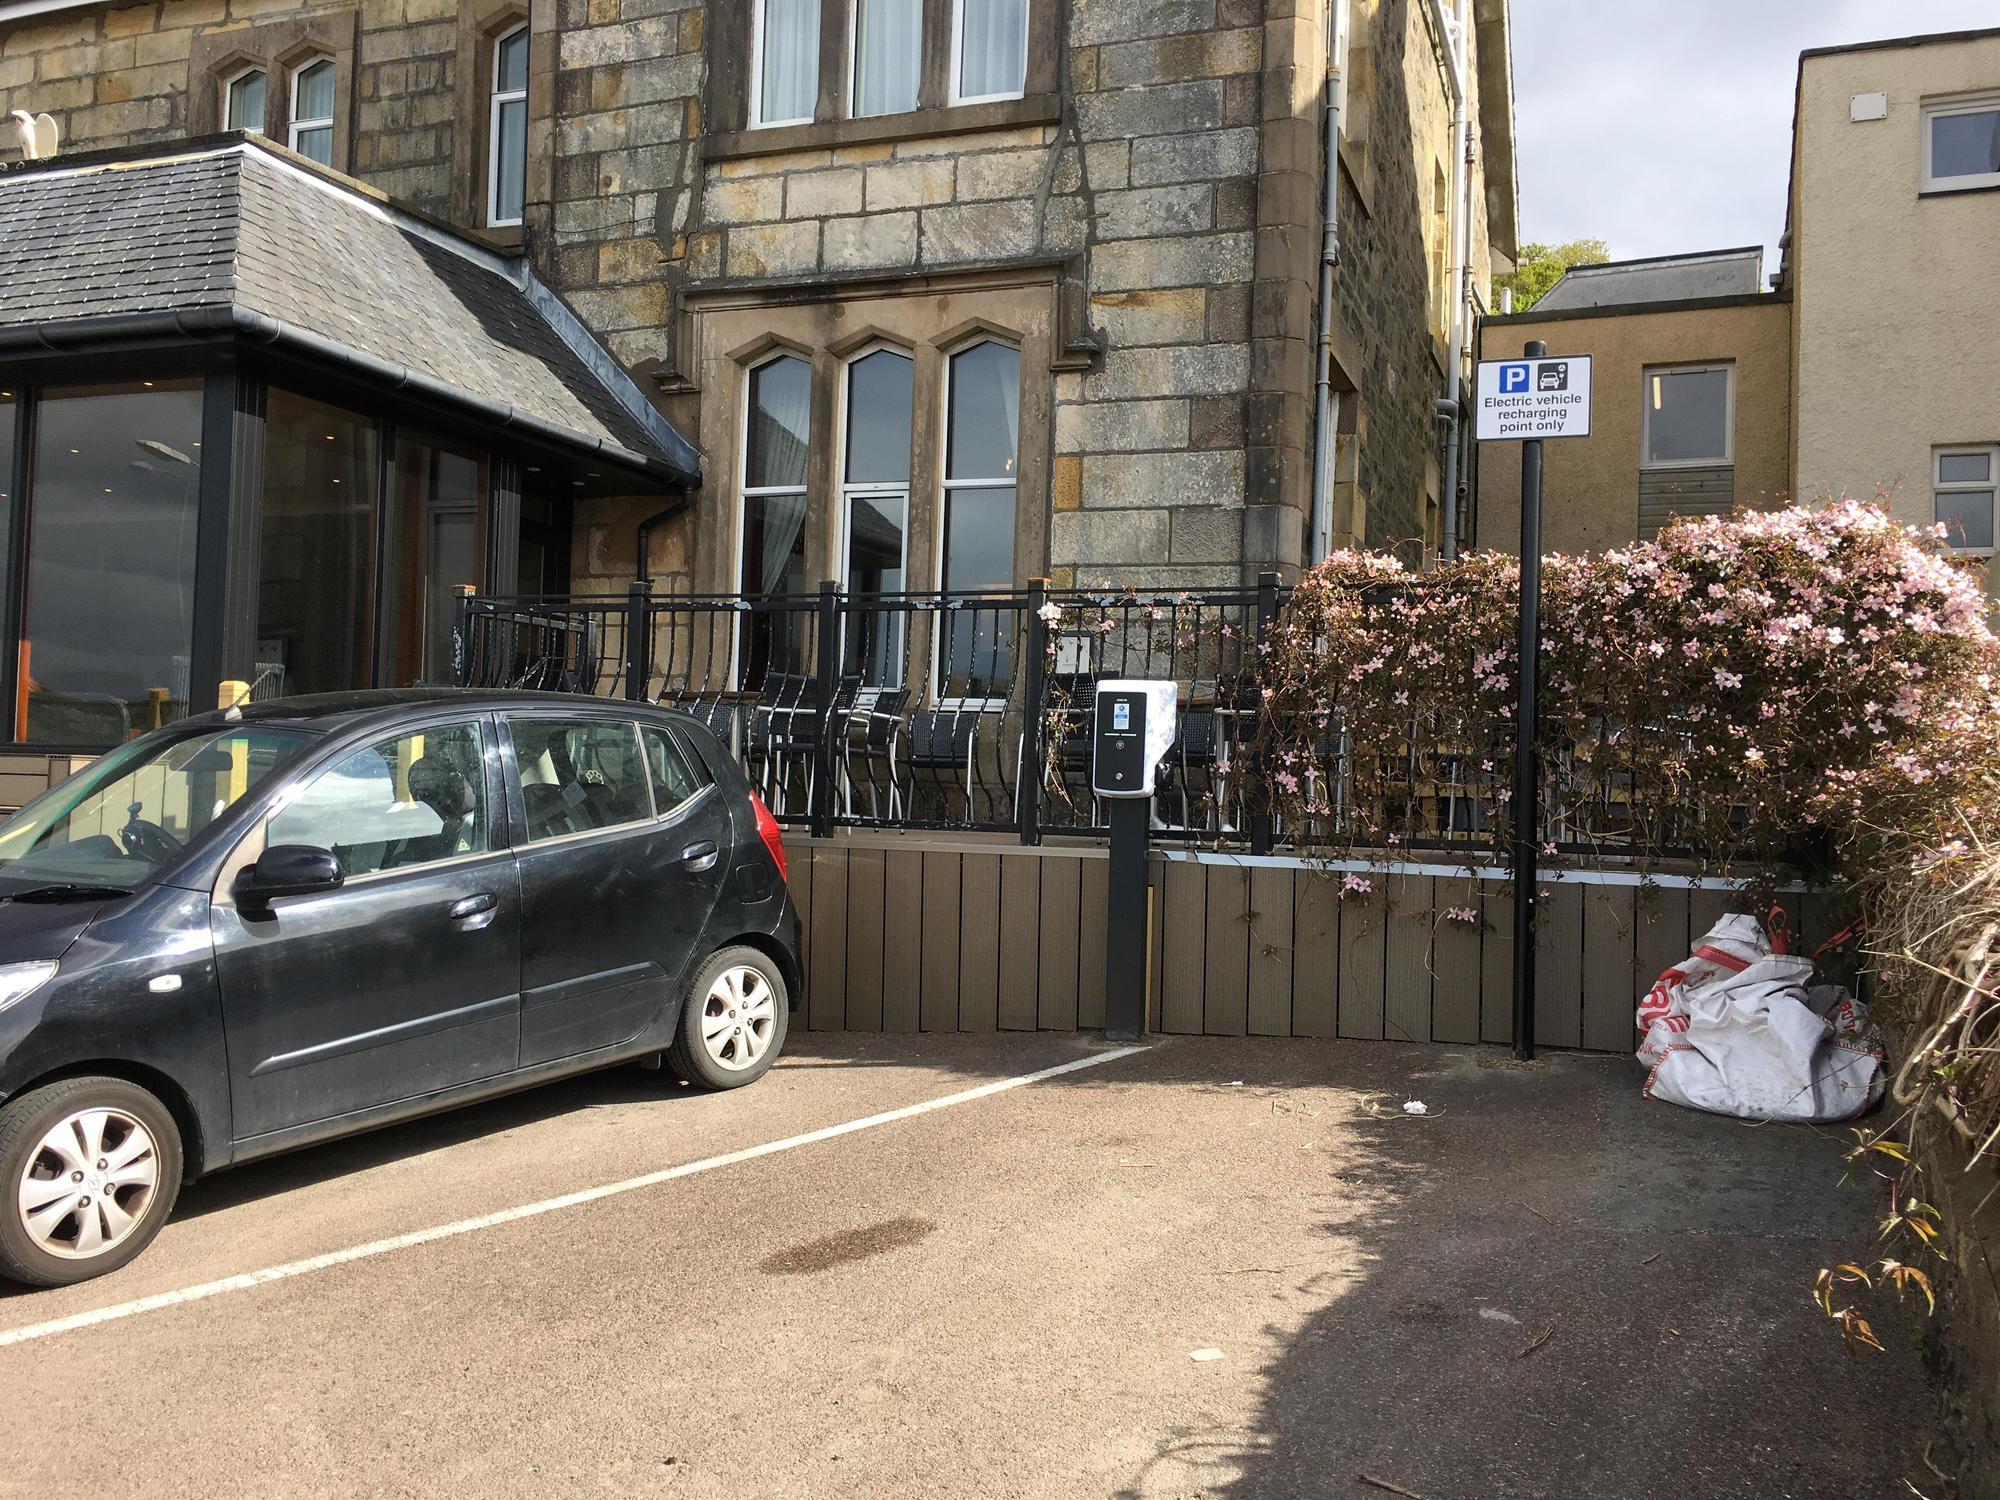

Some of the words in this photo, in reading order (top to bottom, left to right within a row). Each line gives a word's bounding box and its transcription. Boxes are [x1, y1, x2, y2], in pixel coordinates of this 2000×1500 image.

[1506, 367, 1525, 391] P
[1484, 396, 1532, 408] Electric
[1536, 393, 1582, 405] vehicle
[1498, 407, 1567, 420] recharging
[1500, 421, 1532, 434] point
[1536, 420, 1564, 432] only
